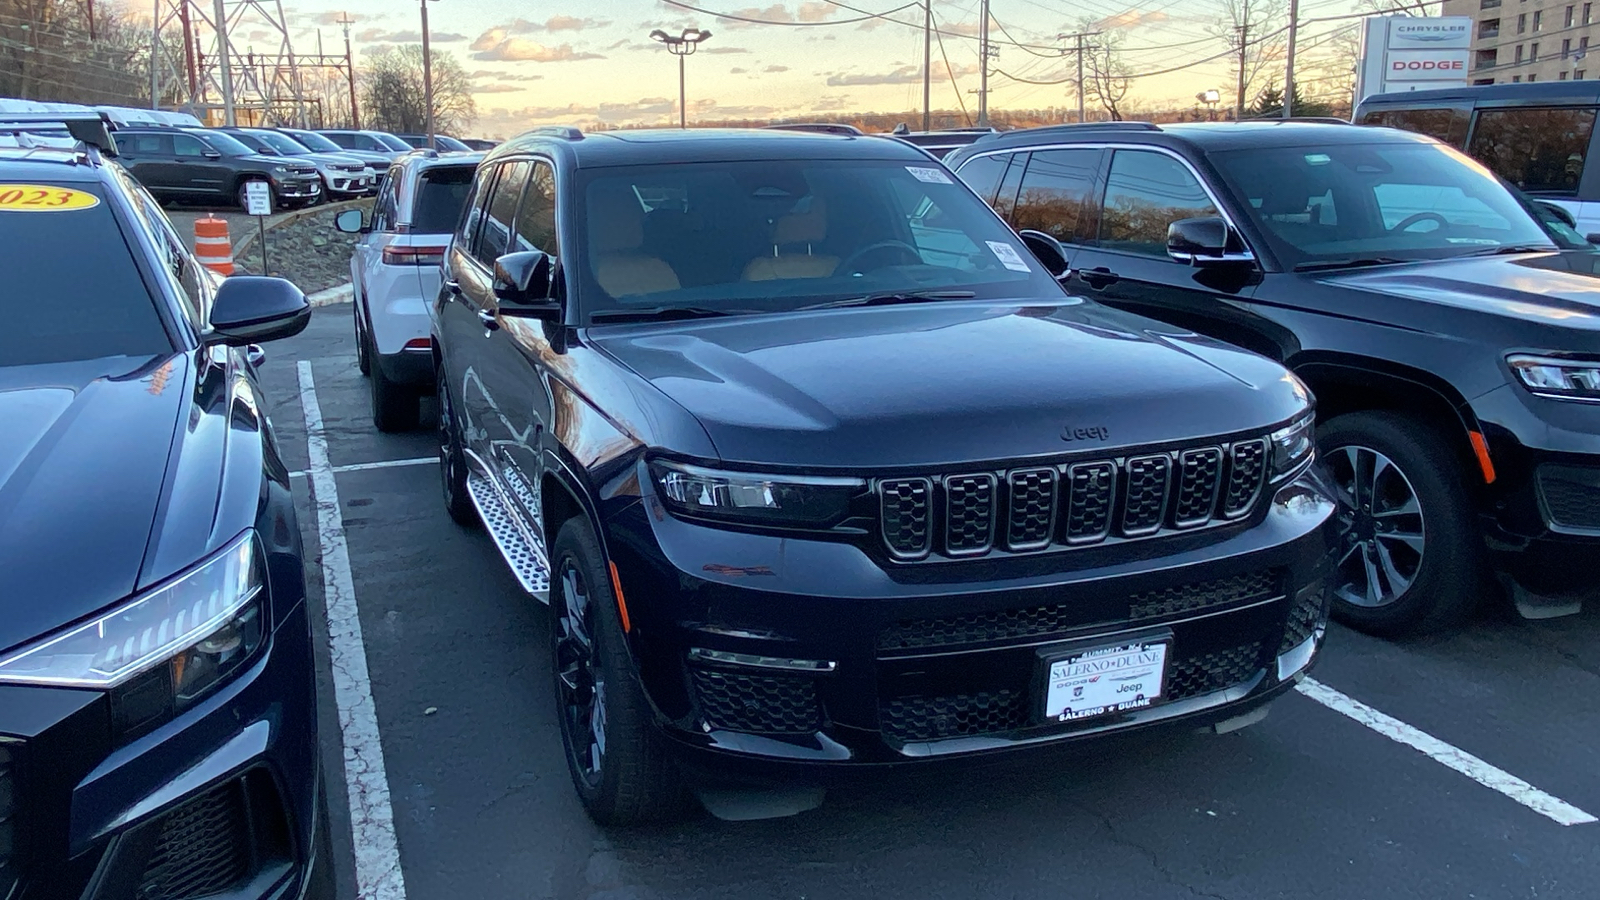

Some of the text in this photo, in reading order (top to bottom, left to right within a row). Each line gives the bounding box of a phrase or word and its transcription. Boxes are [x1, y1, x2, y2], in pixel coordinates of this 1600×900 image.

[1393, 61, 1463, 71] DODGE
[1060, 426, 1109, 441] Jeep
[1052, 661, 1110, 679] SALERNO
[1117, 651, 1160, 668] DUANE
[1116, 683, 1143, 693] Jeep
[1059, 699, 1150, 722] SALERNO DUANE
